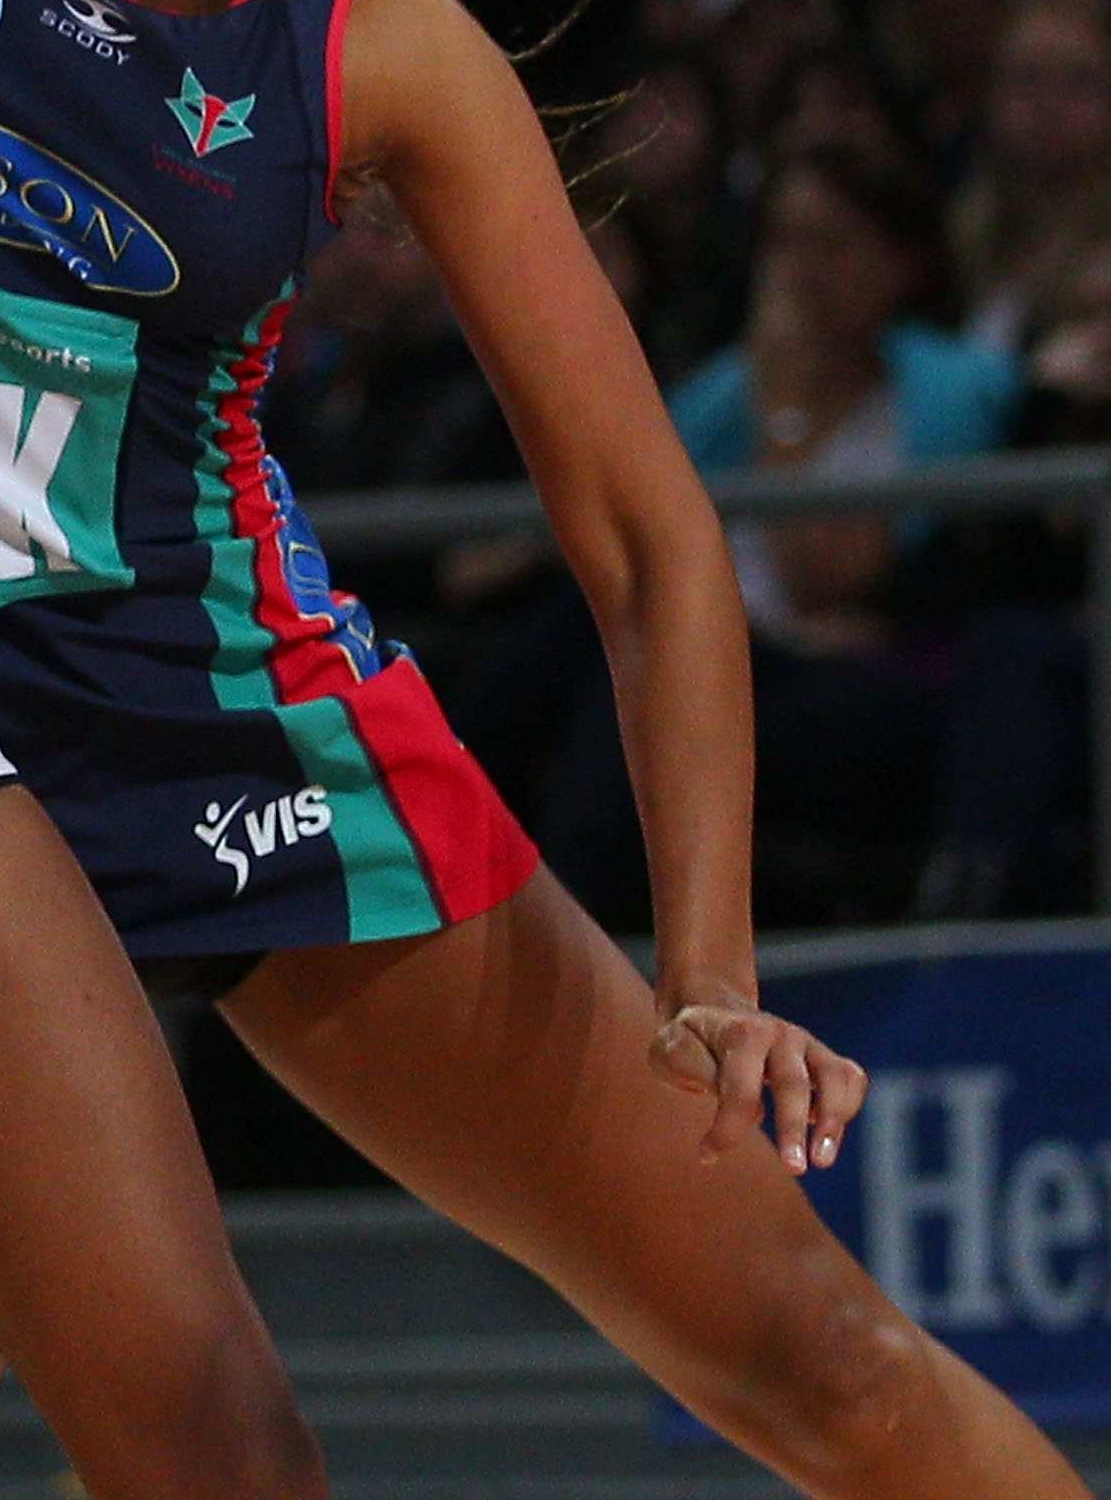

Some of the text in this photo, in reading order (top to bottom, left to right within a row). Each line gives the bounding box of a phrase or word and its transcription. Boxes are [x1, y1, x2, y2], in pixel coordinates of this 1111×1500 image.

[39, 8, 130, 65] SCODY
[244, 784, 332, 857] VIS
[860, 1064, 1111, 1332] He
